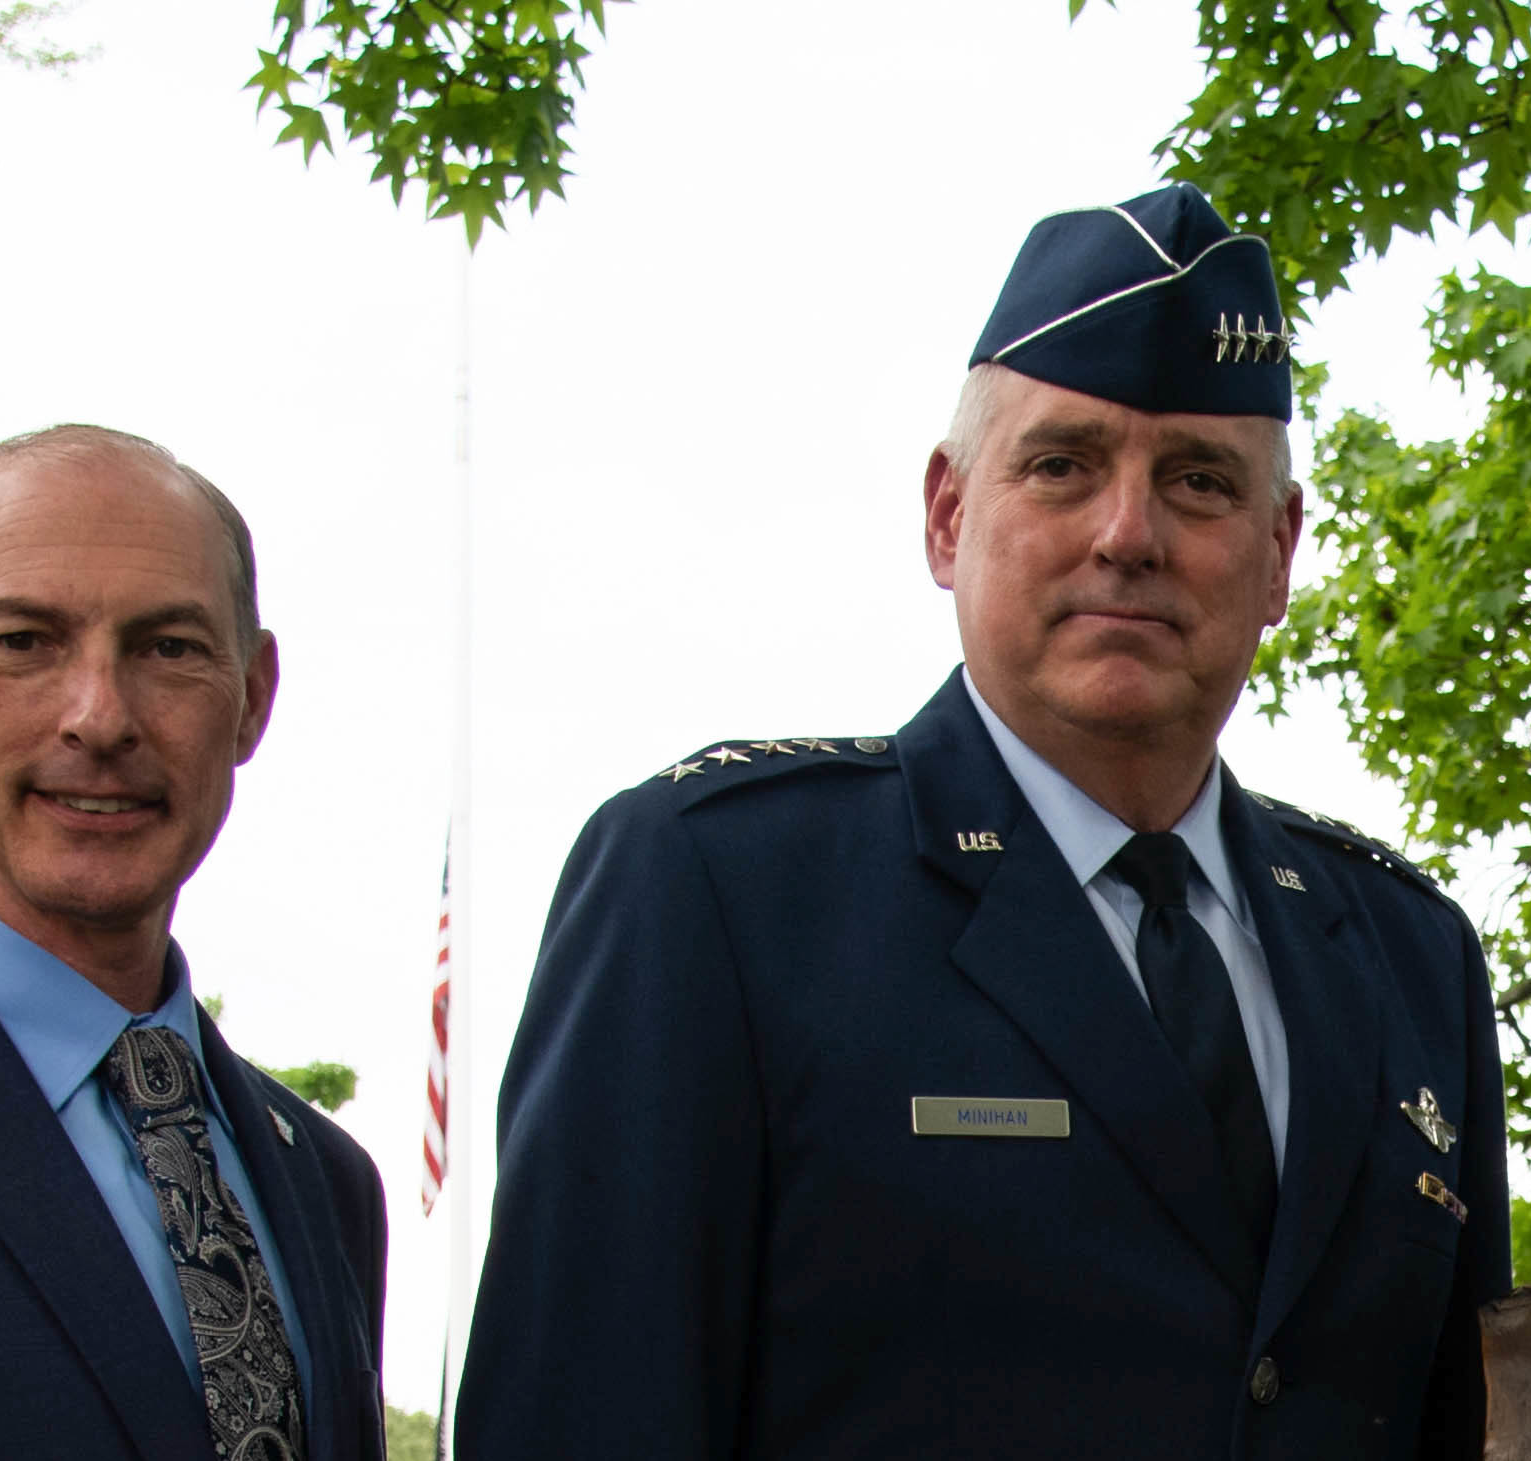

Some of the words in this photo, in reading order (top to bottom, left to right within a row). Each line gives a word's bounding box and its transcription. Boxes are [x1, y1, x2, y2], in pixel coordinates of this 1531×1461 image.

[957, 832, 1004, 851] U.S.
[1271, 865, 1307, 892] U.S.
[957, 1109, 1028, 1126] MINIHAN
